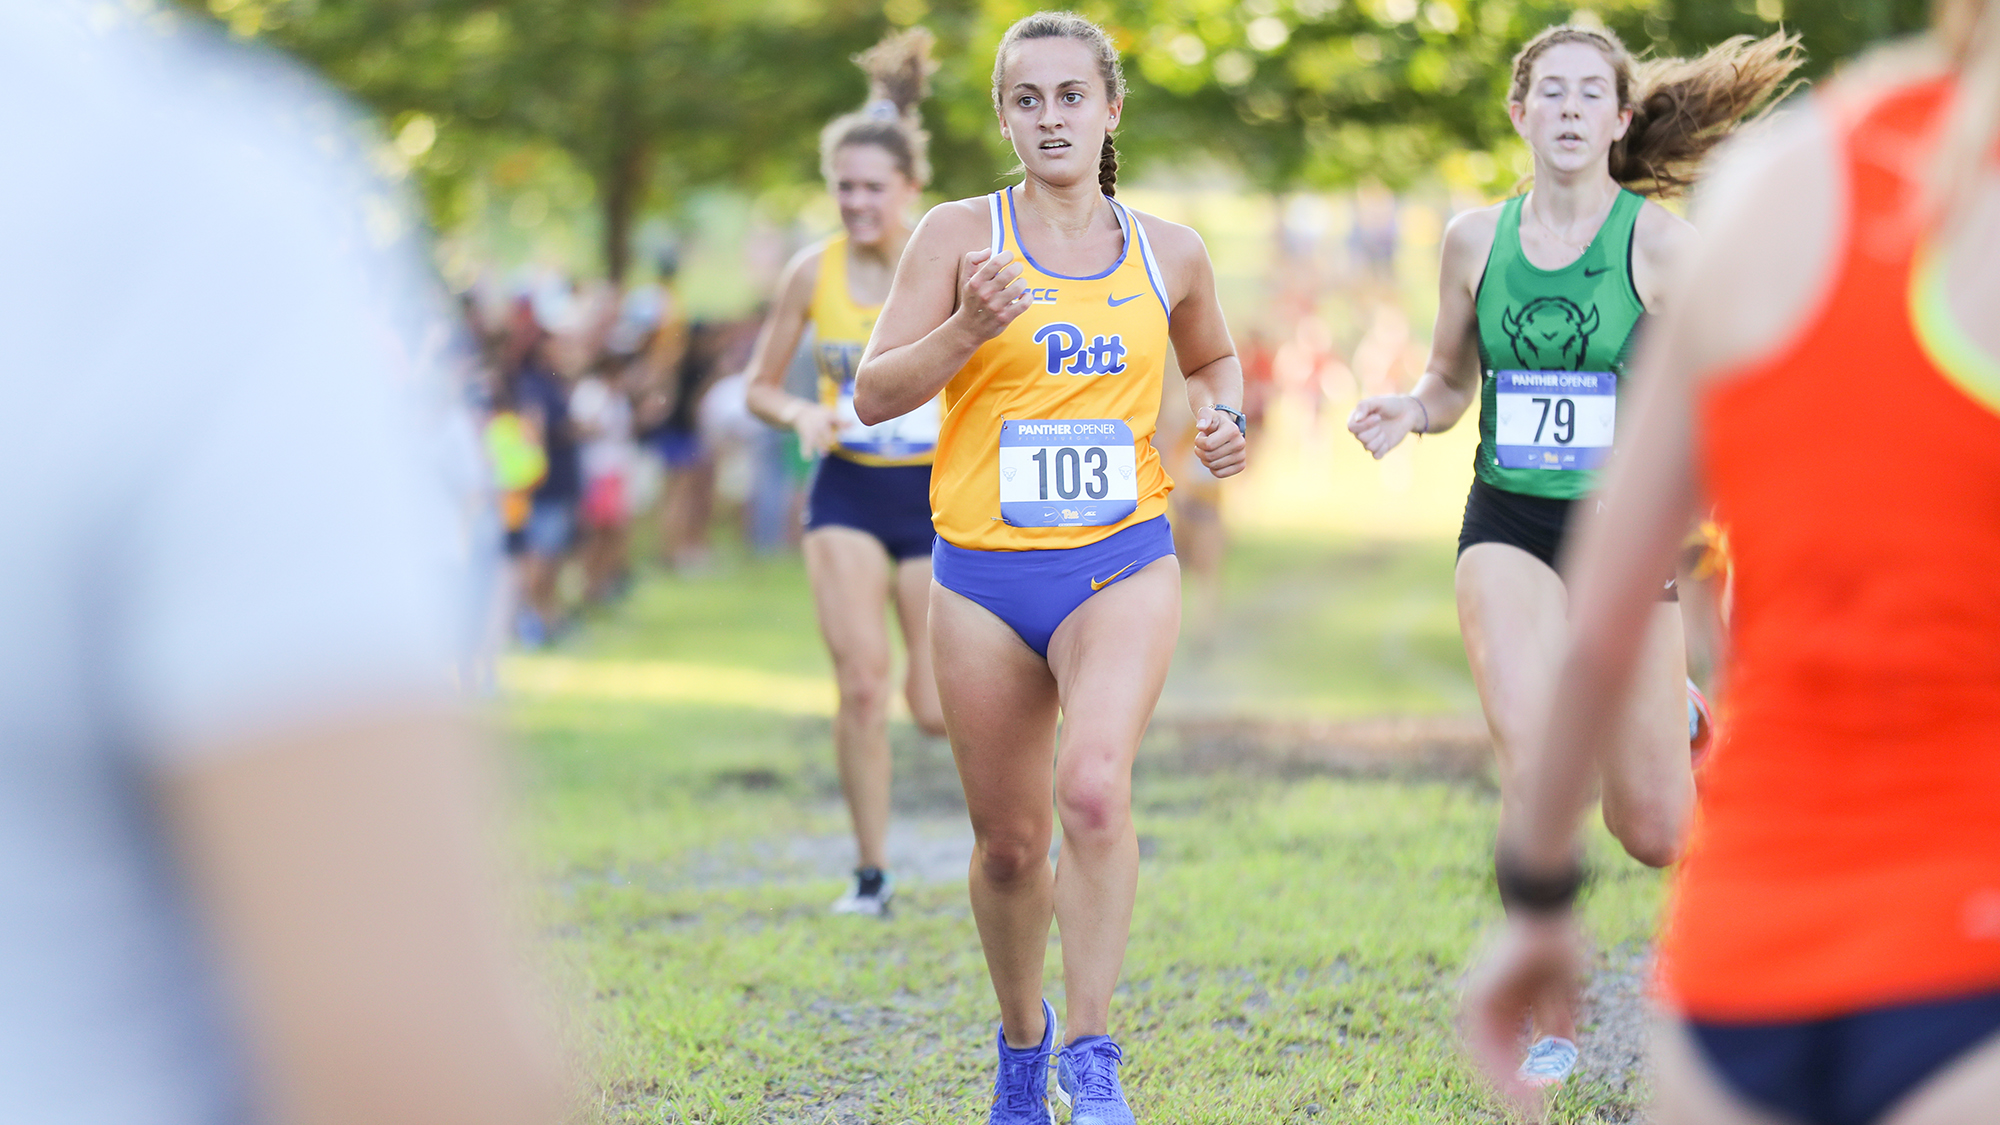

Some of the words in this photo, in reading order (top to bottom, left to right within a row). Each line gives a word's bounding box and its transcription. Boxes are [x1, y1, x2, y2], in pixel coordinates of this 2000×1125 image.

[1032, 321, 1128, 377] Pitt
[1511, 374, 1558, 387] PANTHER
[1559, 374, 1598, 388] OPENER
[1018, 424, 1072, 435] PANTHER
[1073, 424, 1116, 435] OPENER
[1532, 397, 1575, 444] 79
[1032, 447, 1109, 500] 103
